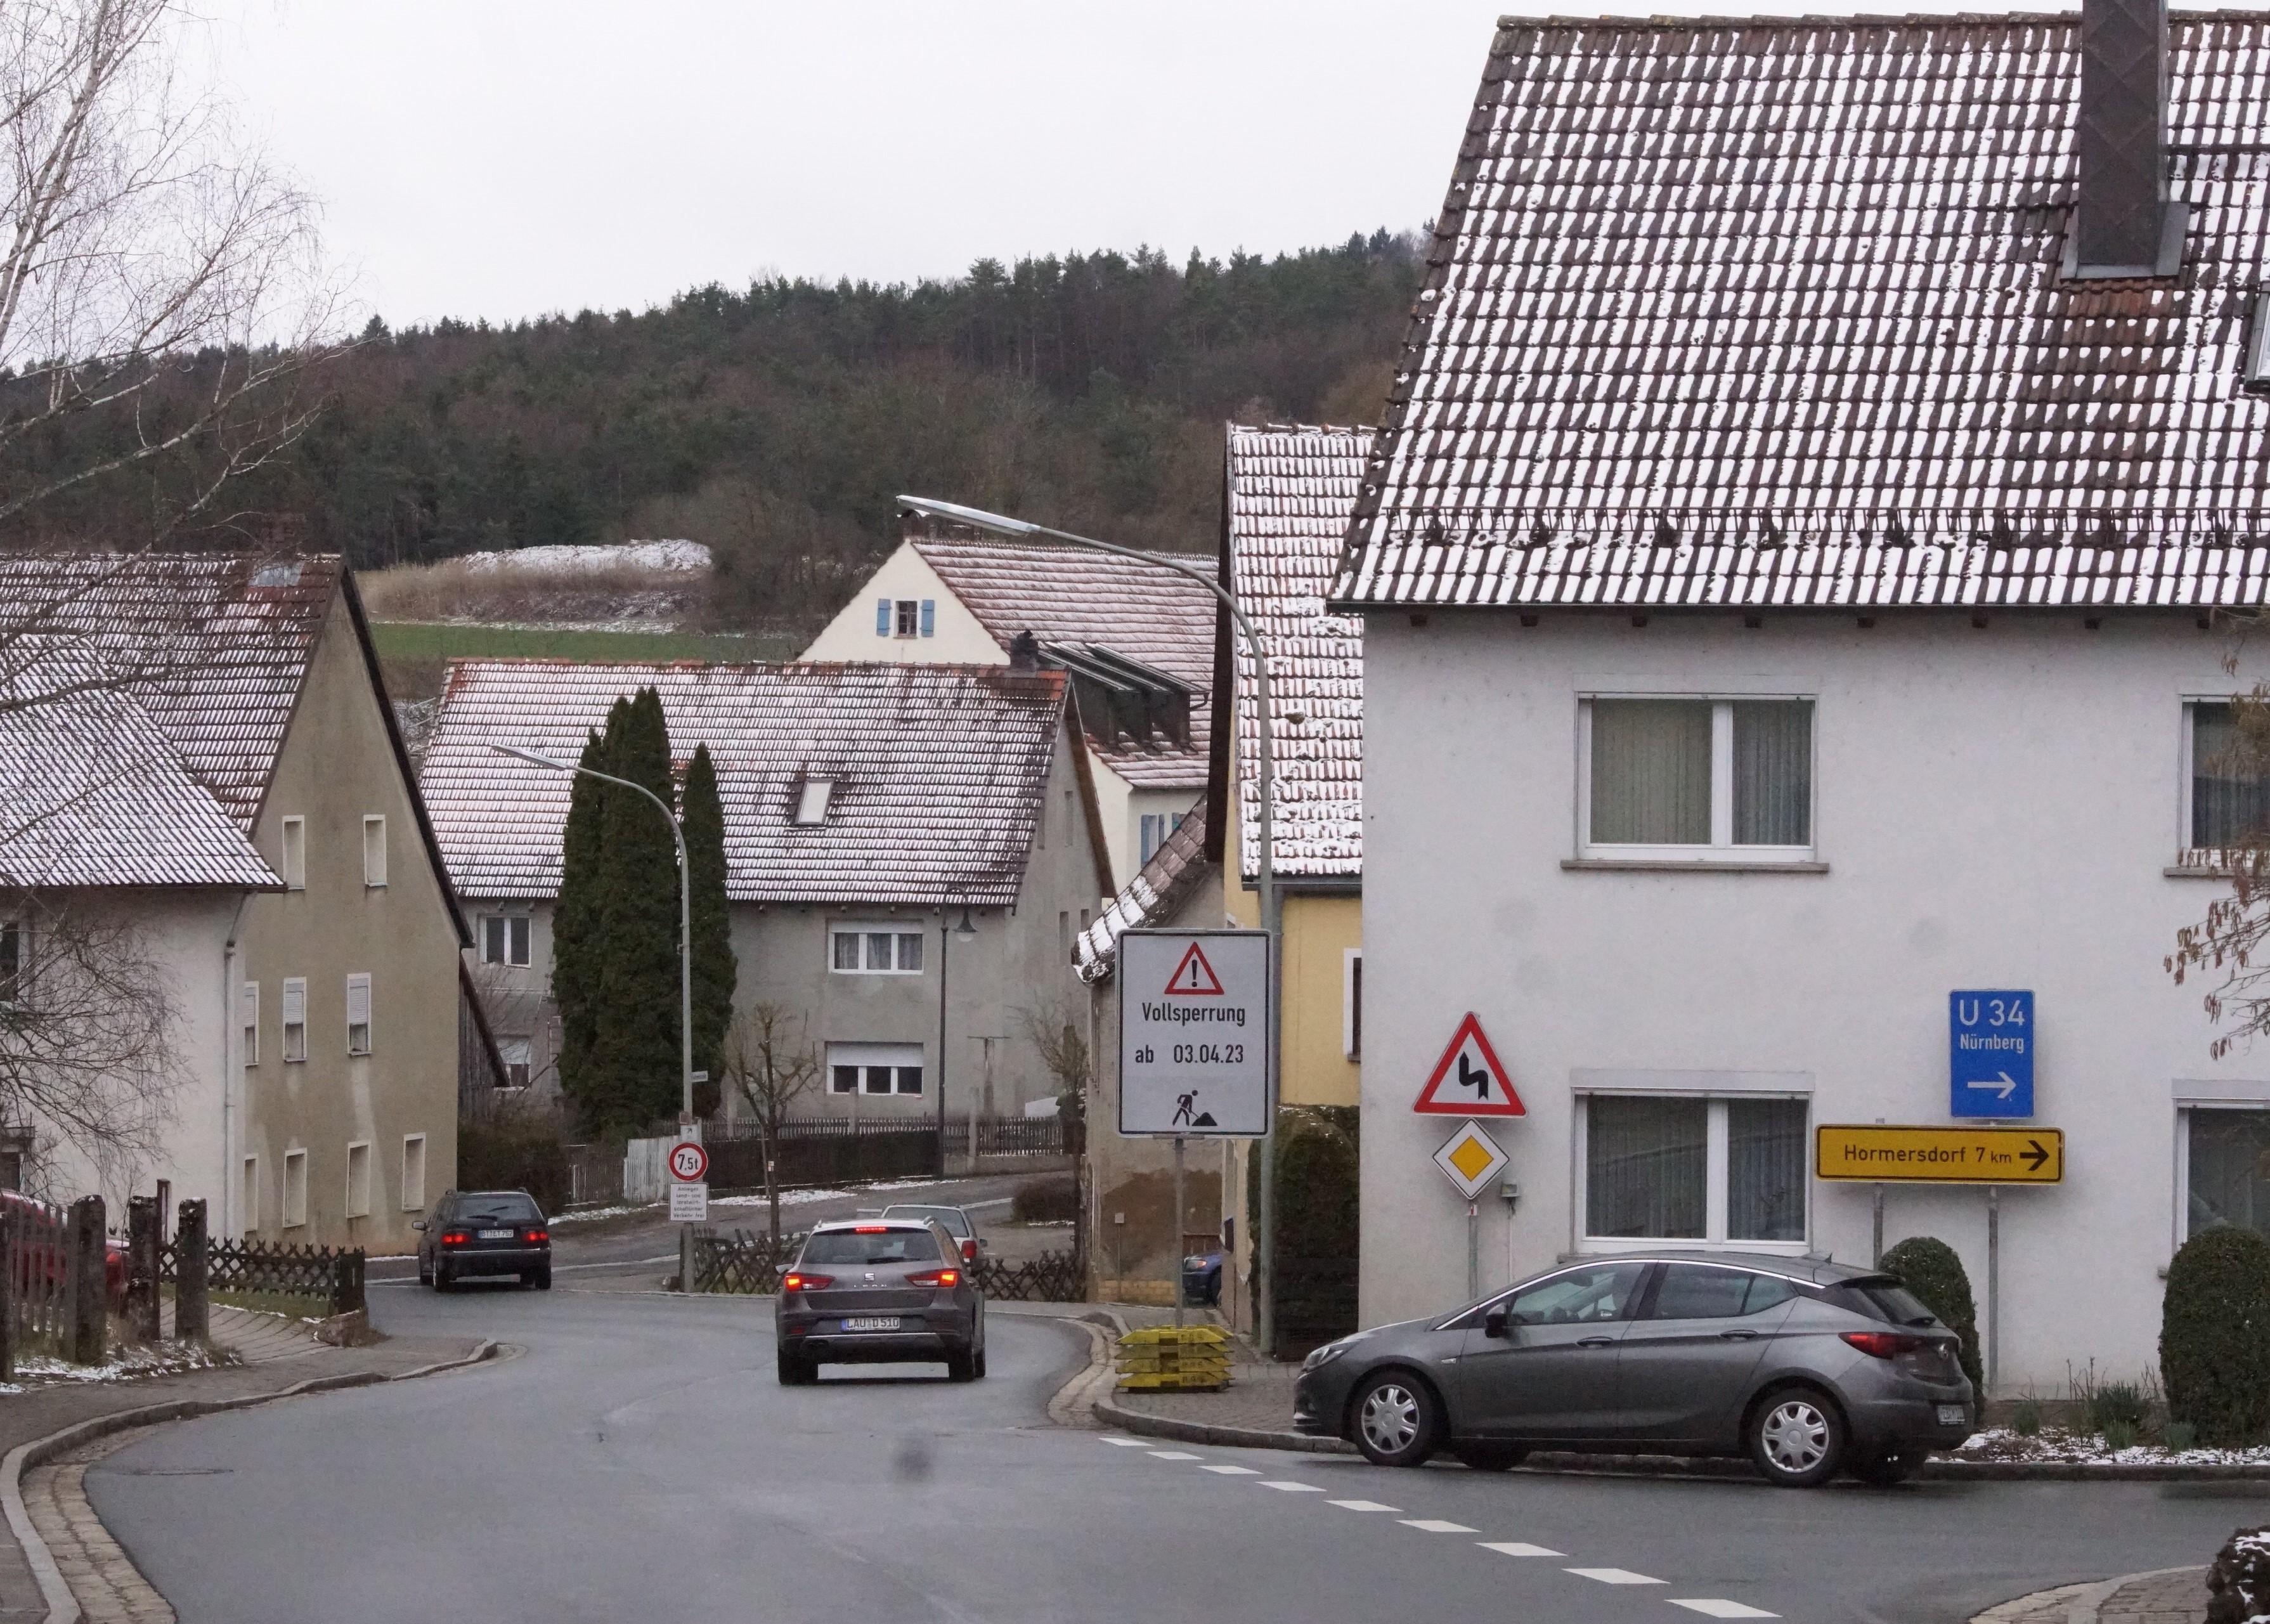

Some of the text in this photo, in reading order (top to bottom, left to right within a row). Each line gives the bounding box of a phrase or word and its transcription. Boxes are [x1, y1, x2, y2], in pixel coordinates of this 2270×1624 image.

[1141, 1002, 1245, 1027] Vollsperrung
[1959, 999, 2025, 1027] U 34
[1135, 1044, 1243, 1063] ab 03.04.23
[1960, 1033, 2025, 1054] Nürnberg
[1845, 1144, 2012, 1164] Hormersdorf 7 km
[847, 1318, 899, 1328] LAU D 510
